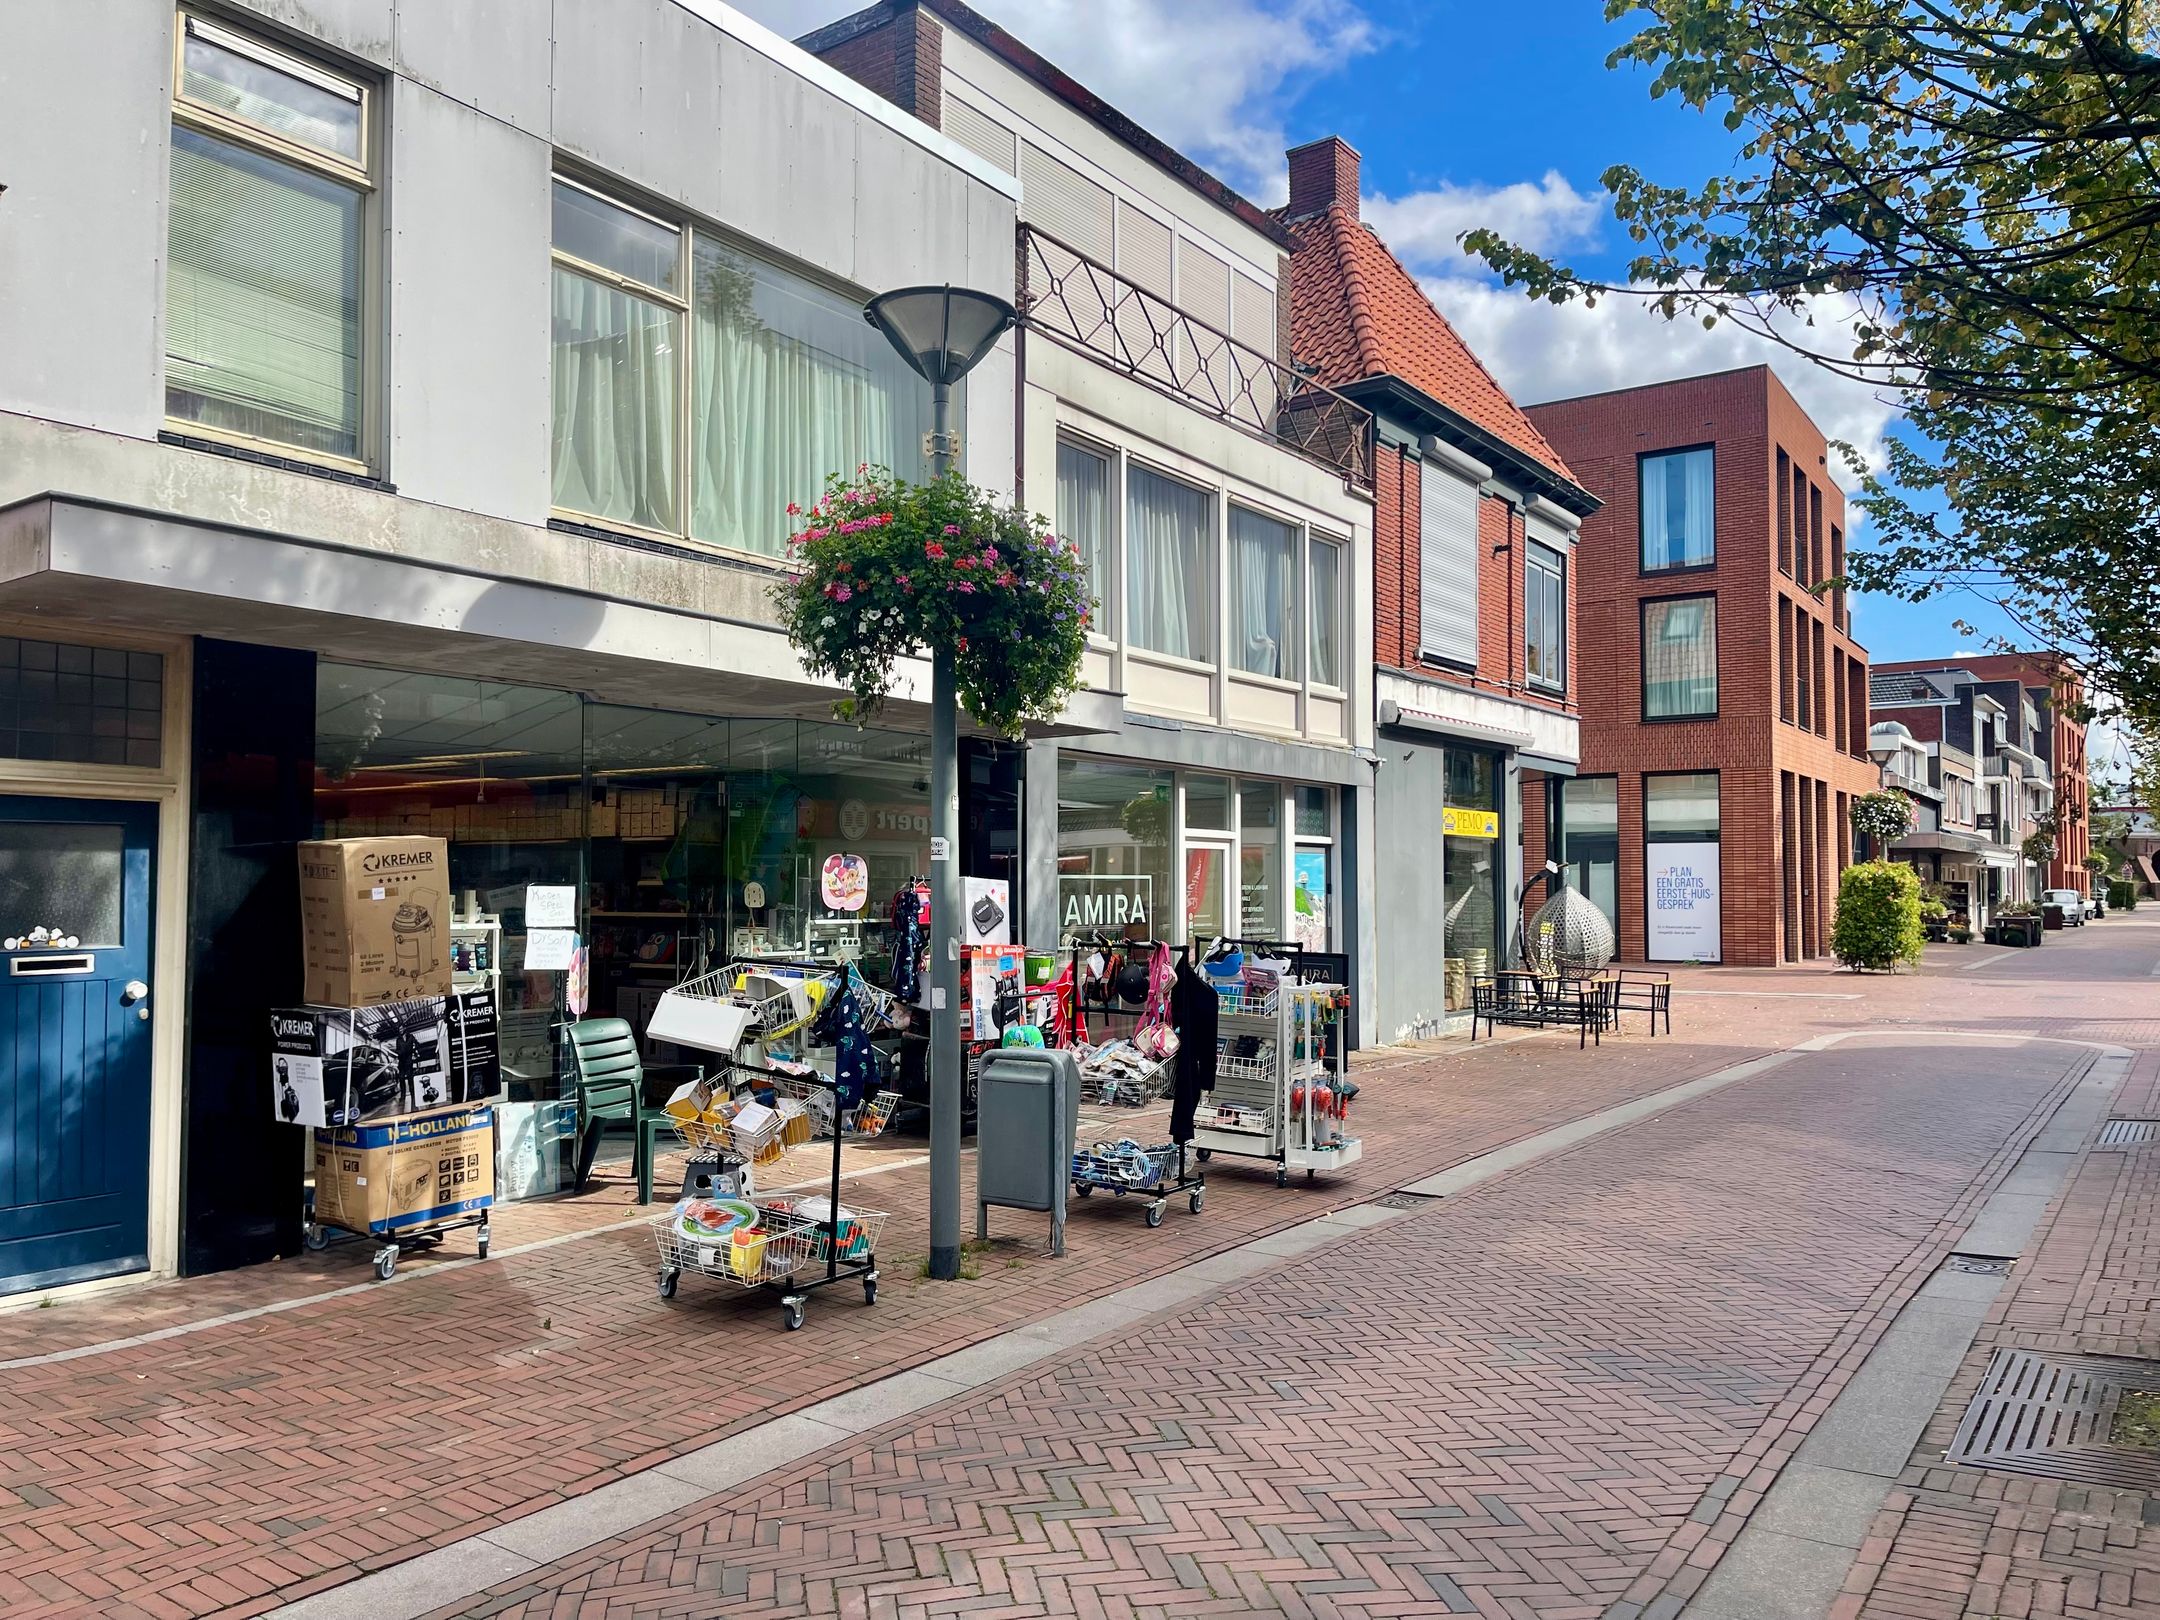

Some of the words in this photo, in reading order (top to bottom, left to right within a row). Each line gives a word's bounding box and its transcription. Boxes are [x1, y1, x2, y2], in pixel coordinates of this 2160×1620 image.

[1457, 812, 1482, 829] PEMO
[382, 851, 433, 867] KREMER
[1670, 867, 1692, 877] PLAN
[1657, 878, 1672, 888] EEN
[1674, 878, 1704, 888] GRATIS
[1657, 888, 1714, 899] EERSTE-HUIS-
[1064, 894, 1146, 926] AMIRA
[1657, 899, 1694, 910] GESPREK
[462, 1006, 494, 1018] KREMER
[282, 1019, 315, 1036] KREMER
[510, 1160, 518, 1193] Puppy
